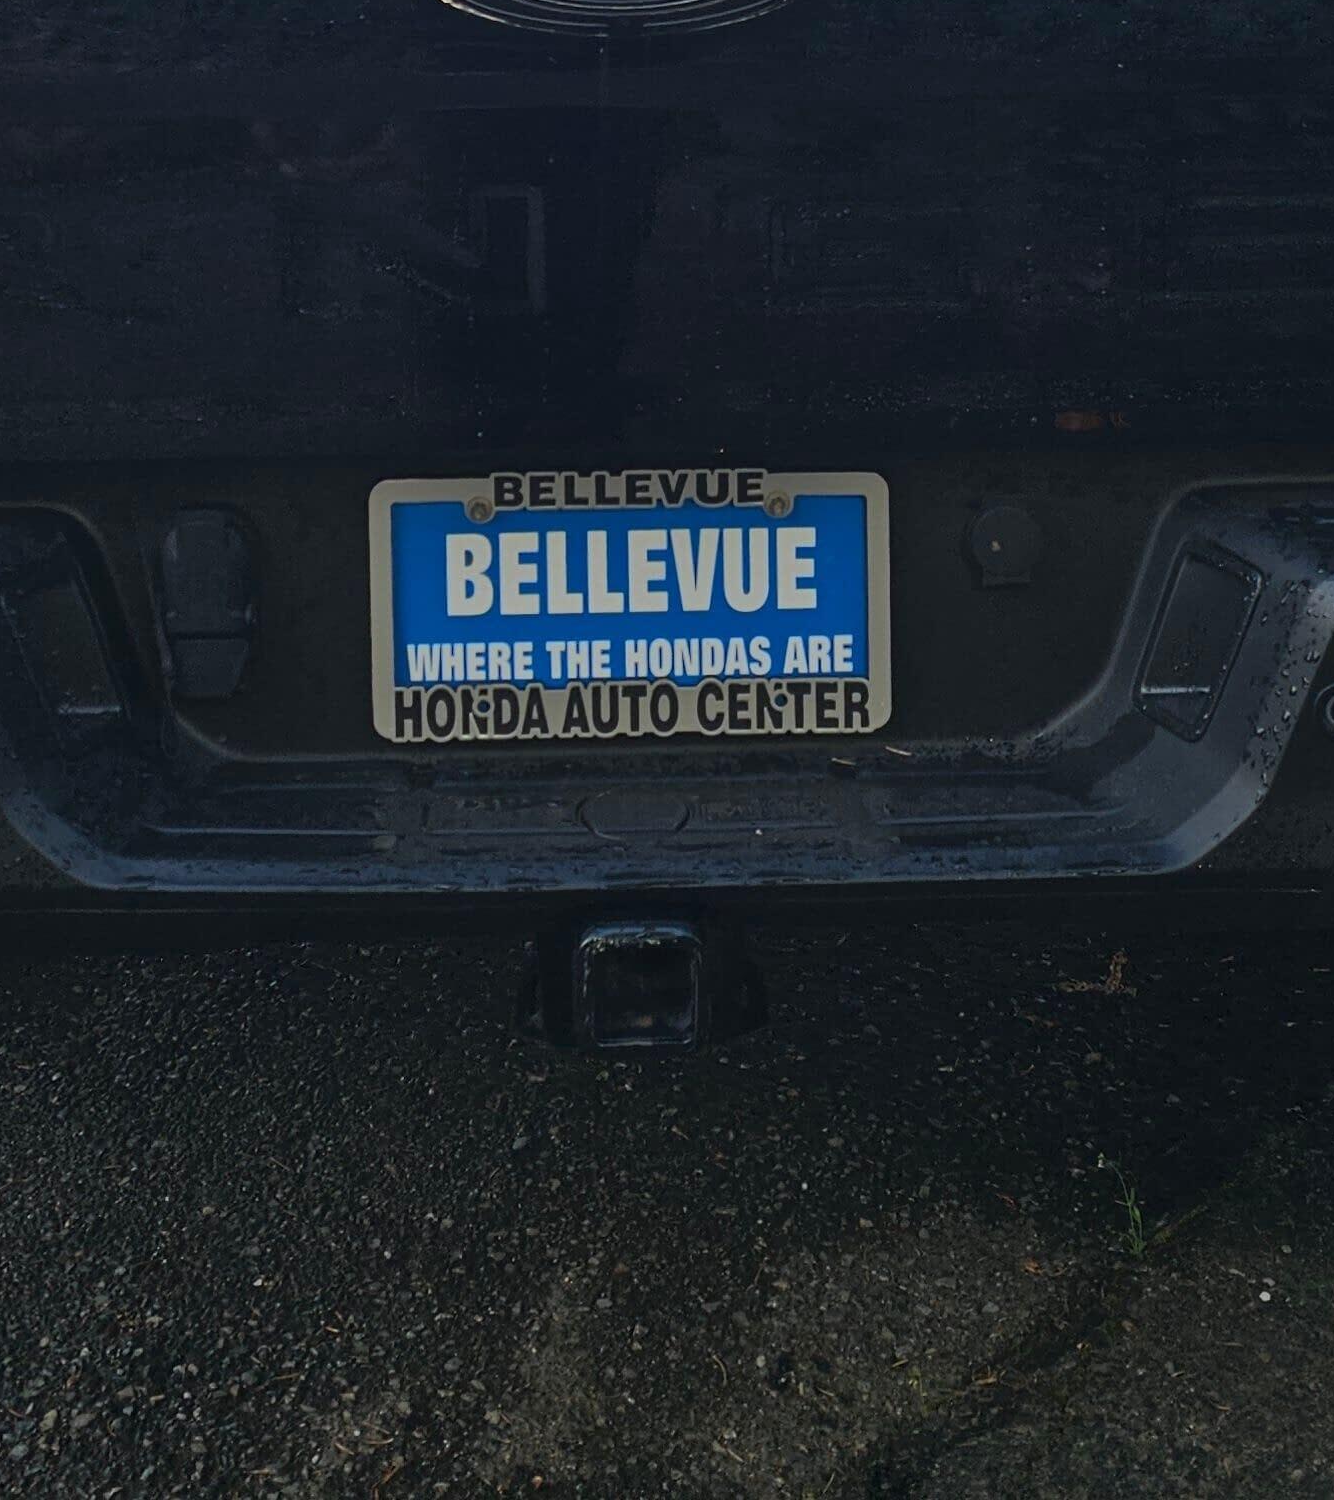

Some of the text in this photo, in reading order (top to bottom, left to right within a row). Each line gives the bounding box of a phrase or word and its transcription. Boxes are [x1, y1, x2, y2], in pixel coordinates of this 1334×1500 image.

[493, 472, 765, 508] BELLEVUE
[445, 527, 817, 616] BELLEVUE
[407, 634, 853, 682] WHERE THE HONDAS ARE
[394, 681, 870, 739] HONDA AUTO CENTER
